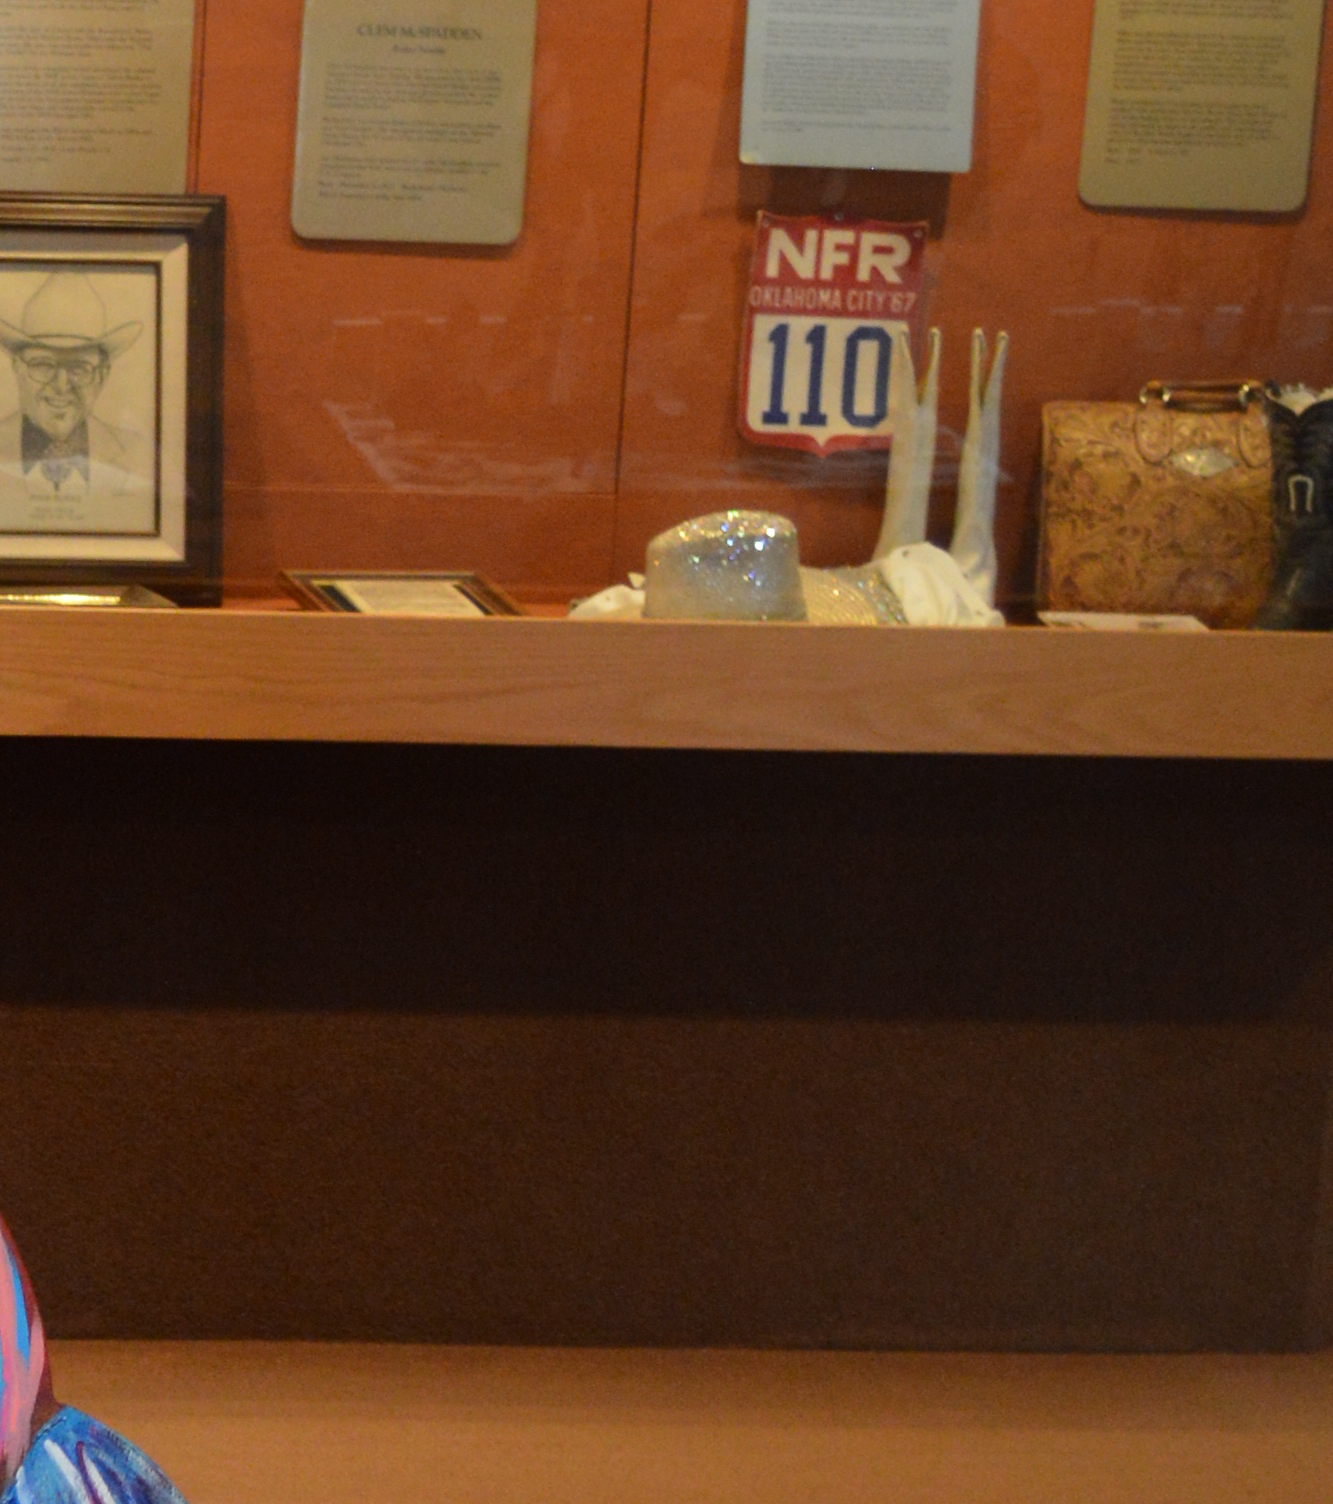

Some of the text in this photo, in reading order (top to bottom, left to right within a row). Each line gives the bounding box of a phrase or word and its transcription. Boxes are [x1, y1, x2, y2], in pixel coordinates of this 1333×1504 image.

[765, 227, 911, 284] NFR
[749, 285, 841, 310] OKLAHOMA
[845, 289, 885, 312] CITY
[762, 323, 892, 428] 110
